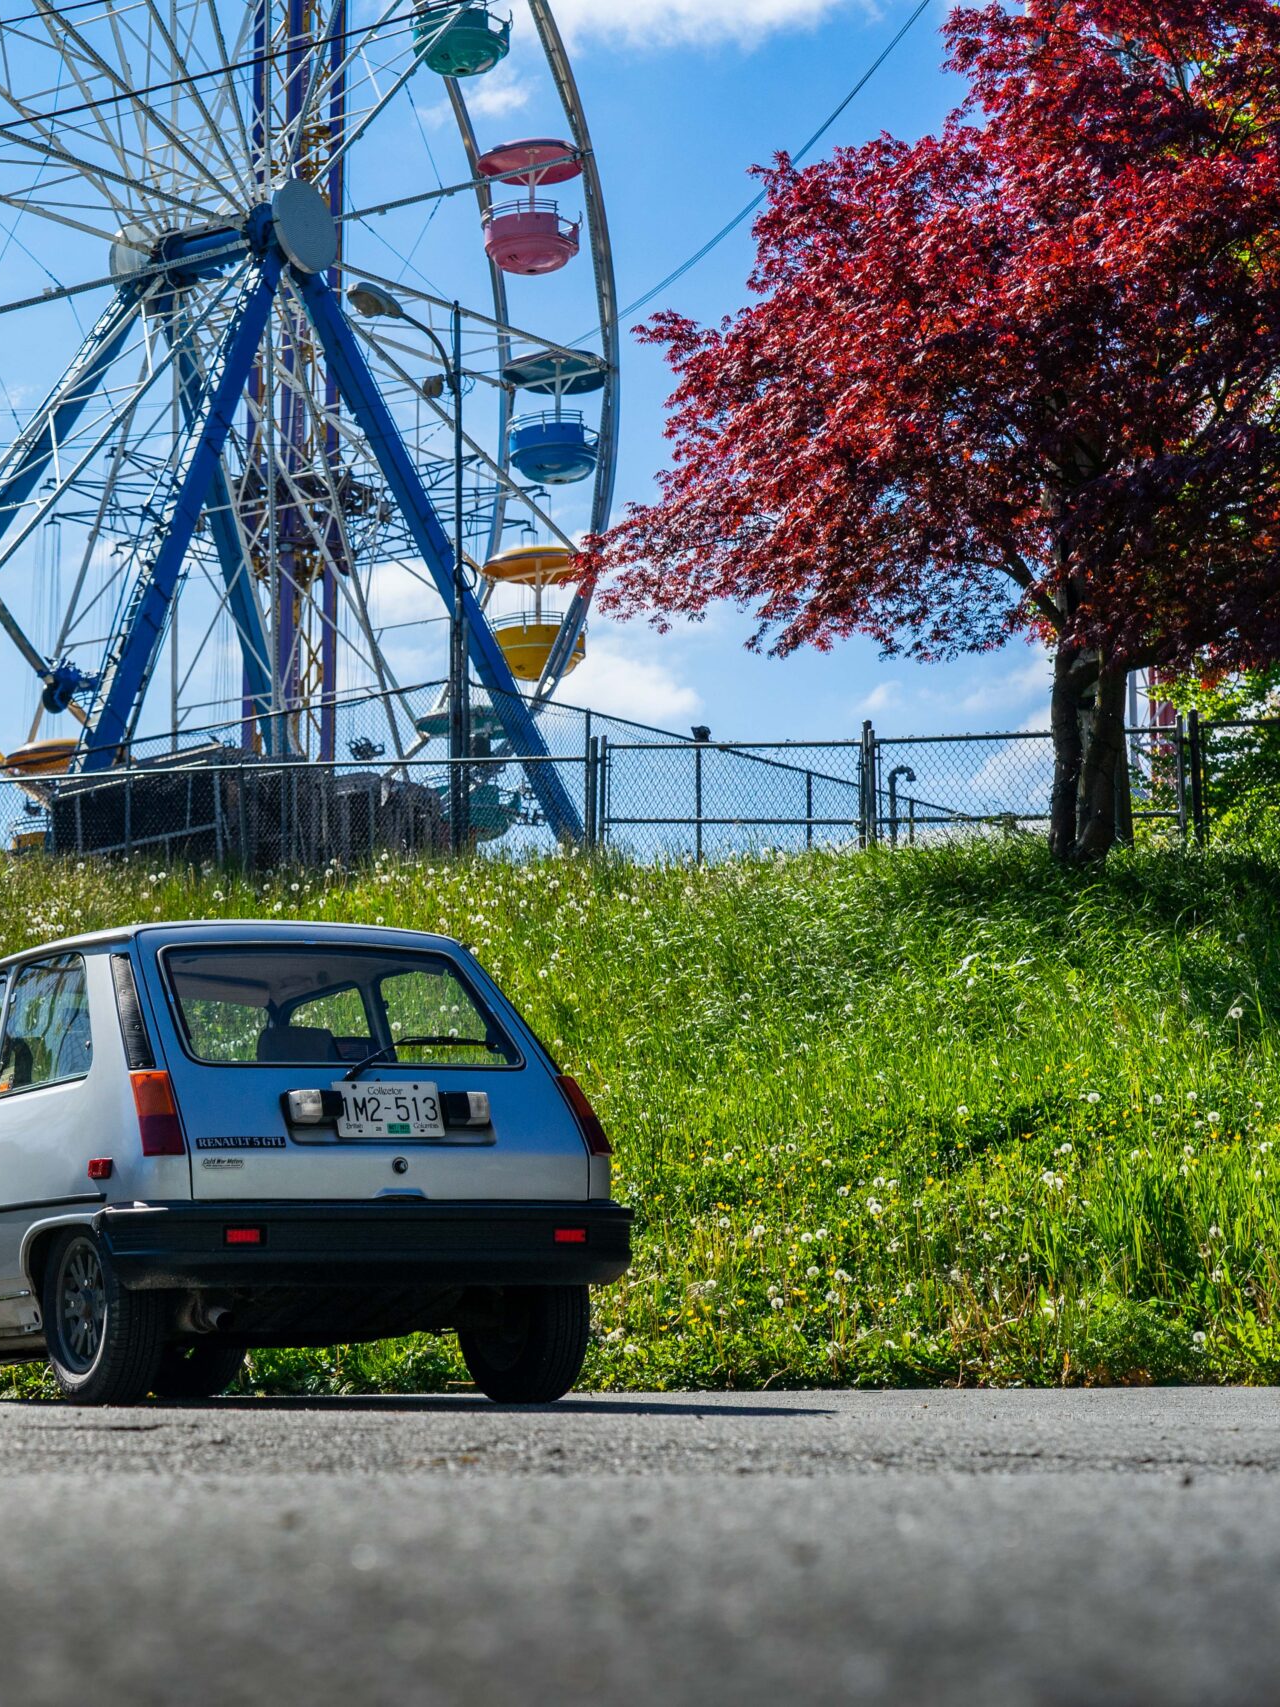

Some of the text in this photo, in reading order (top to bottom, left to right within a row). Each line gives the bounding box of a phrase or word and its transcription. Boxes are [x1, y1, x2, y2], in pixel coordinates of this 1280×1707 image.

[367, 1086, 403, 1096] Collector
[342, 1096, 439, 1122] 1M2-513
[346, 1122, 364, 1130] British
[198, 1136, 286, 1147] RENAULT 5 GTL
